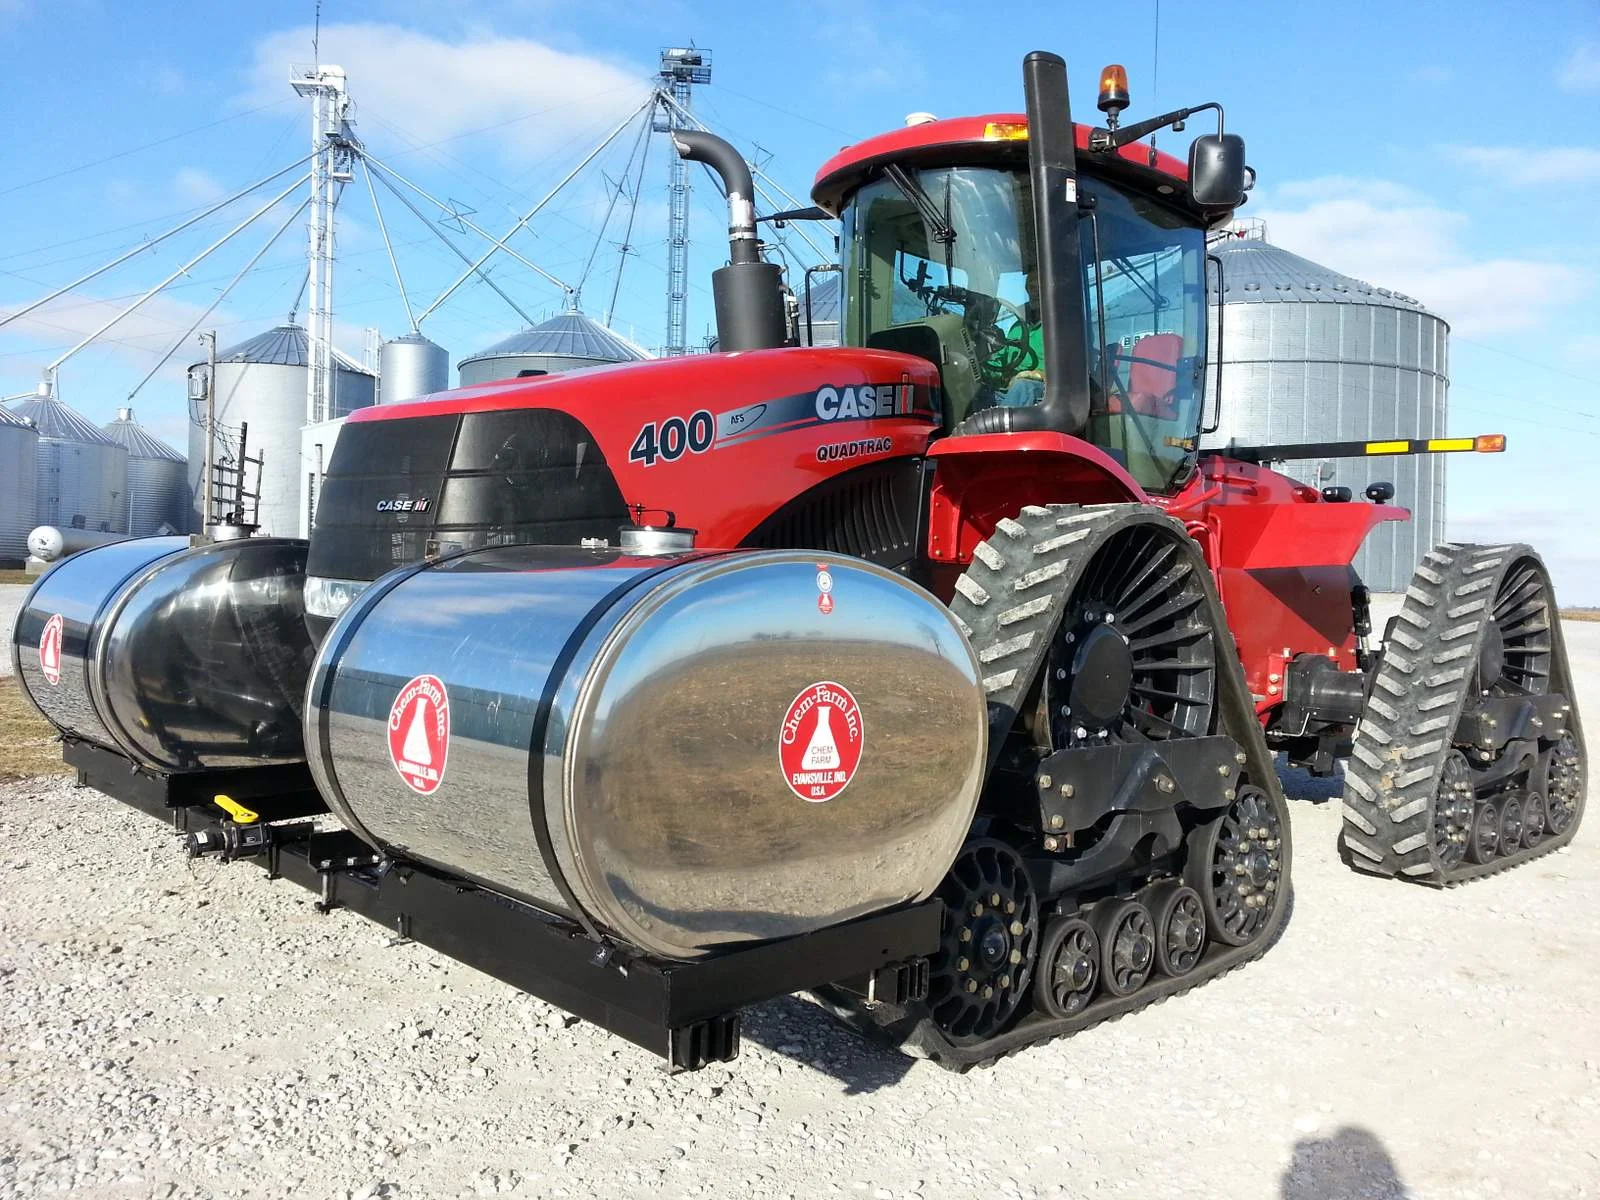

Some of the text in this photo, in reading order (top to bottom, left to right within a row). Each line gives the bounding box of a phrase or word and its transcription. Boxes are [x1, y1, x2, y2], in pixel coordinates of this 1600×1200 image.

[730, 414, 745, 425] AFS
[628, 409, 715, 467] 400
[816, 436, 893, 463] QUADTRAC
[782, 685, 859, 744] Chem-Farm Inc.
[811, 745, 833, 755] CHEM
[811, 755, 832, 765] FARM
